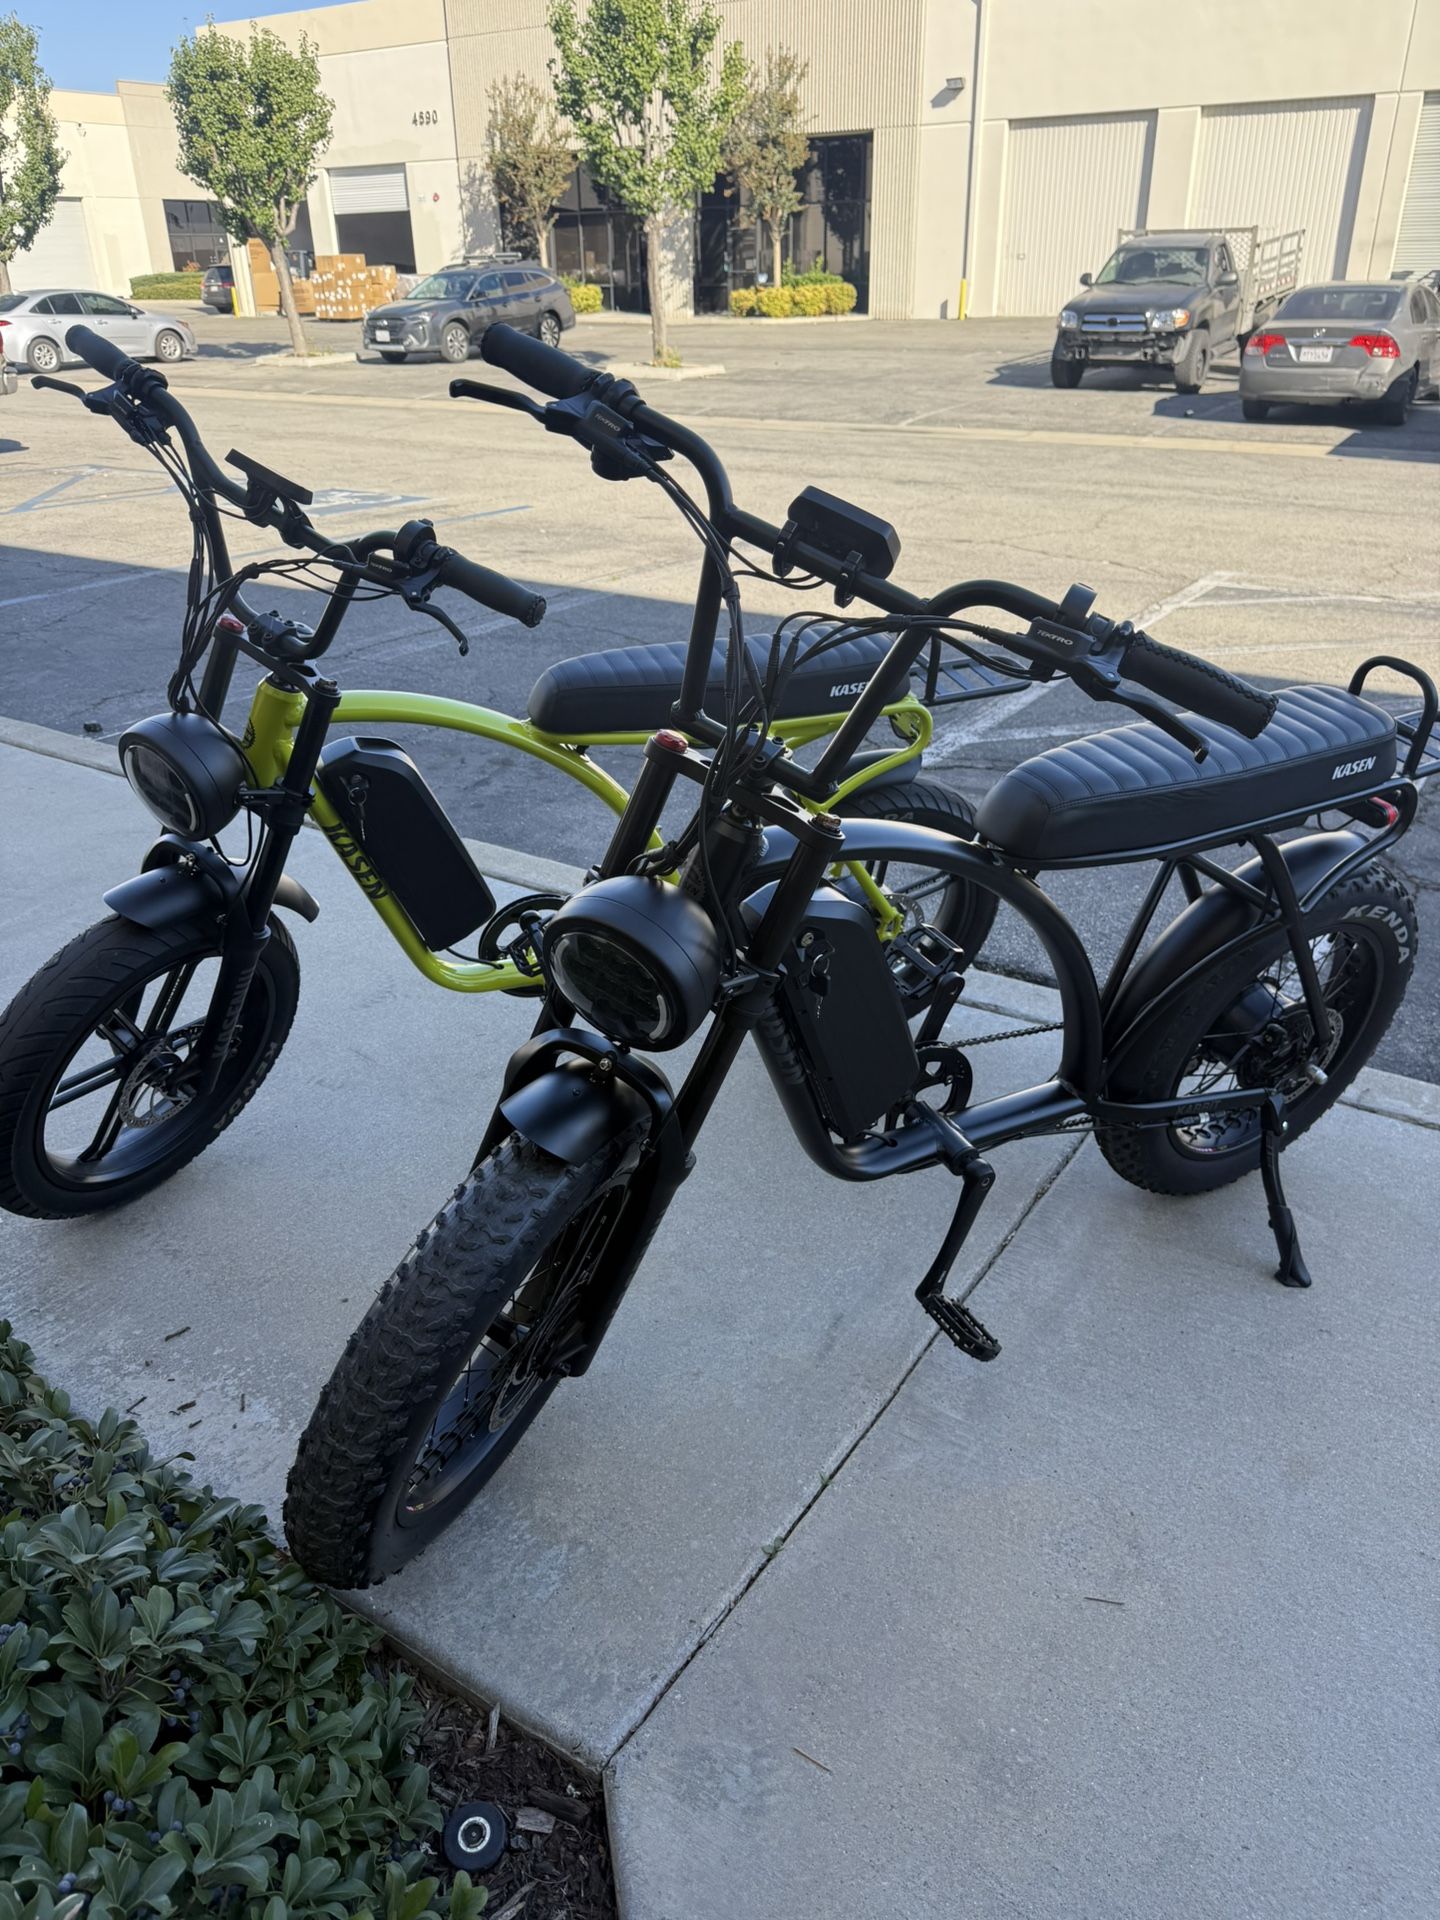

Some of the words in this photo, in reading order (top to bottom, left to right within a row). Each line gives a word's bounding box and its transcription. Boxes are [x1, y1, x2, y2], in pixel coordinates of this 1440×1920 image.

[412, 110, 438, 126] 4590
[830, 681, 870, 697] KASE
[1331, 756, 1377, 780] KASEN
[322, 823, 389, 899] KASEN
[1341, 904, 1410, 964] KENDA
